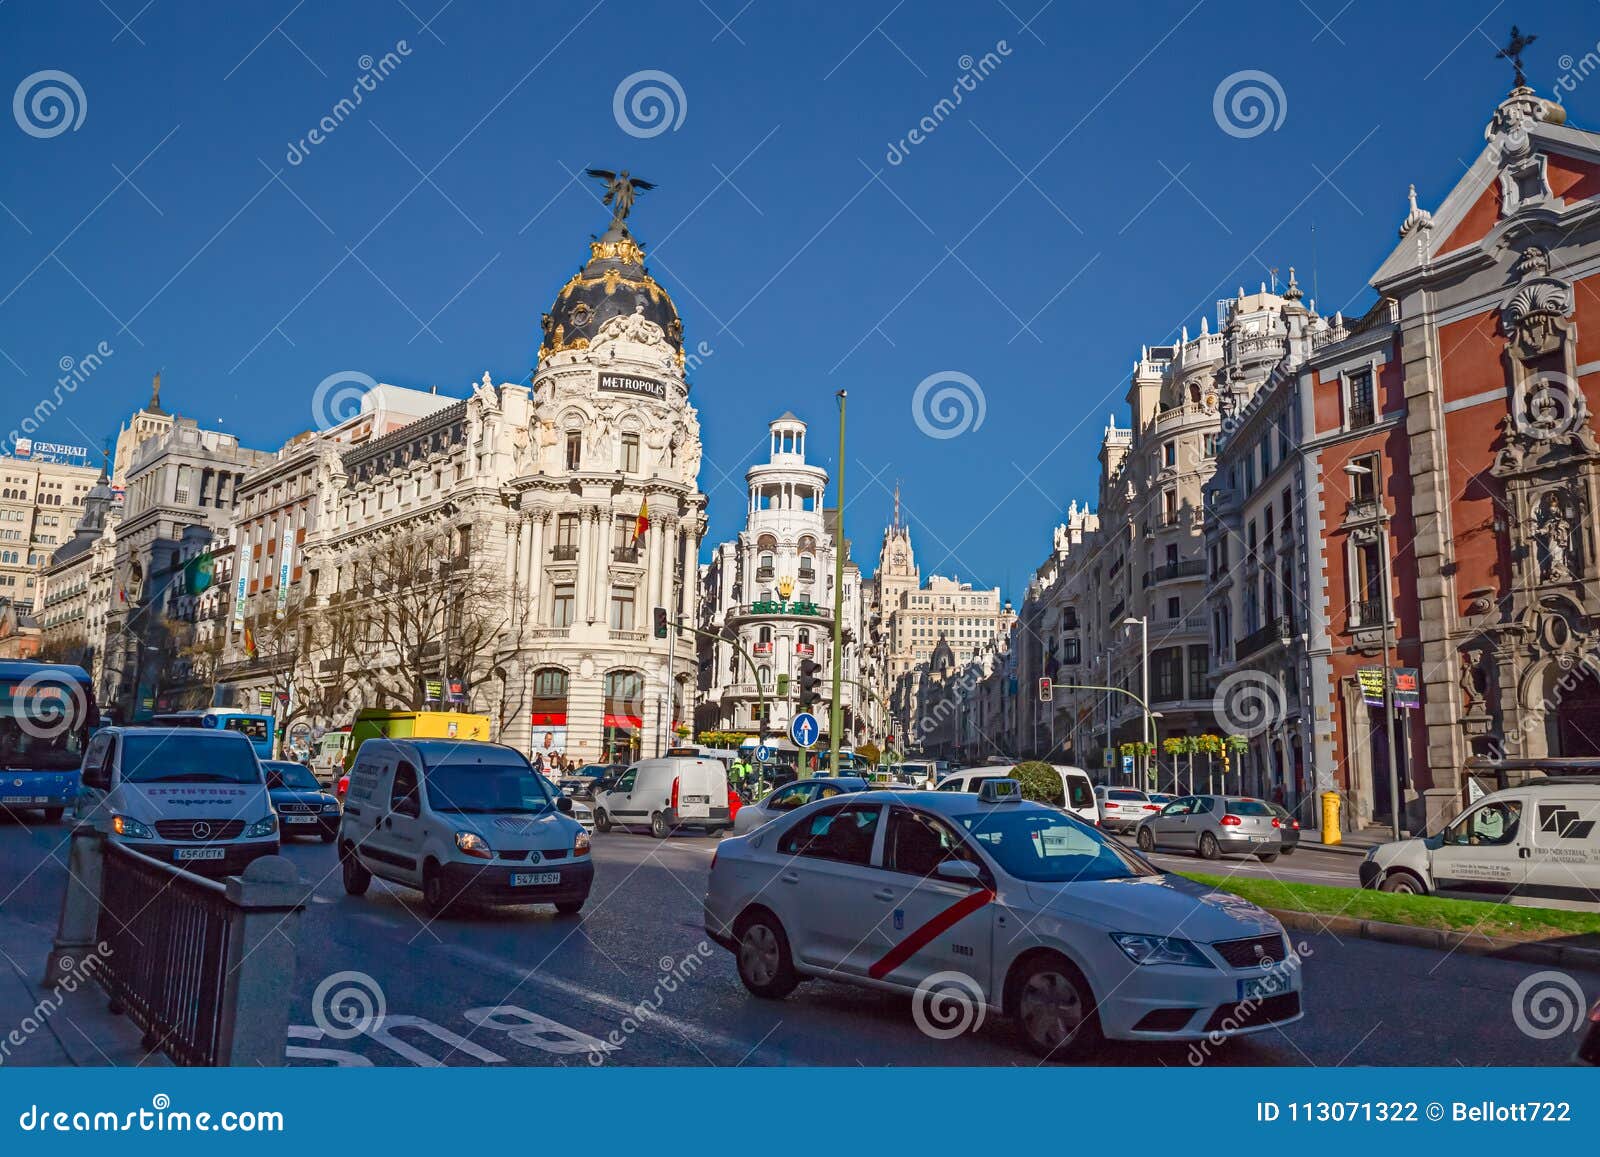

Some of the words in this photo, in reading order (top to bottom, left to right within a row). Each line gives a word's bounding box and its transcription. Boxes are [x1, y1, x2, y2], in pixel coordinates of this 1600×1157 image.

[602, 376, 664, 395] METROPOLIS
[34, 441, 88, 457] GENERALI
[751, 600, 821, 616] ROLEX
